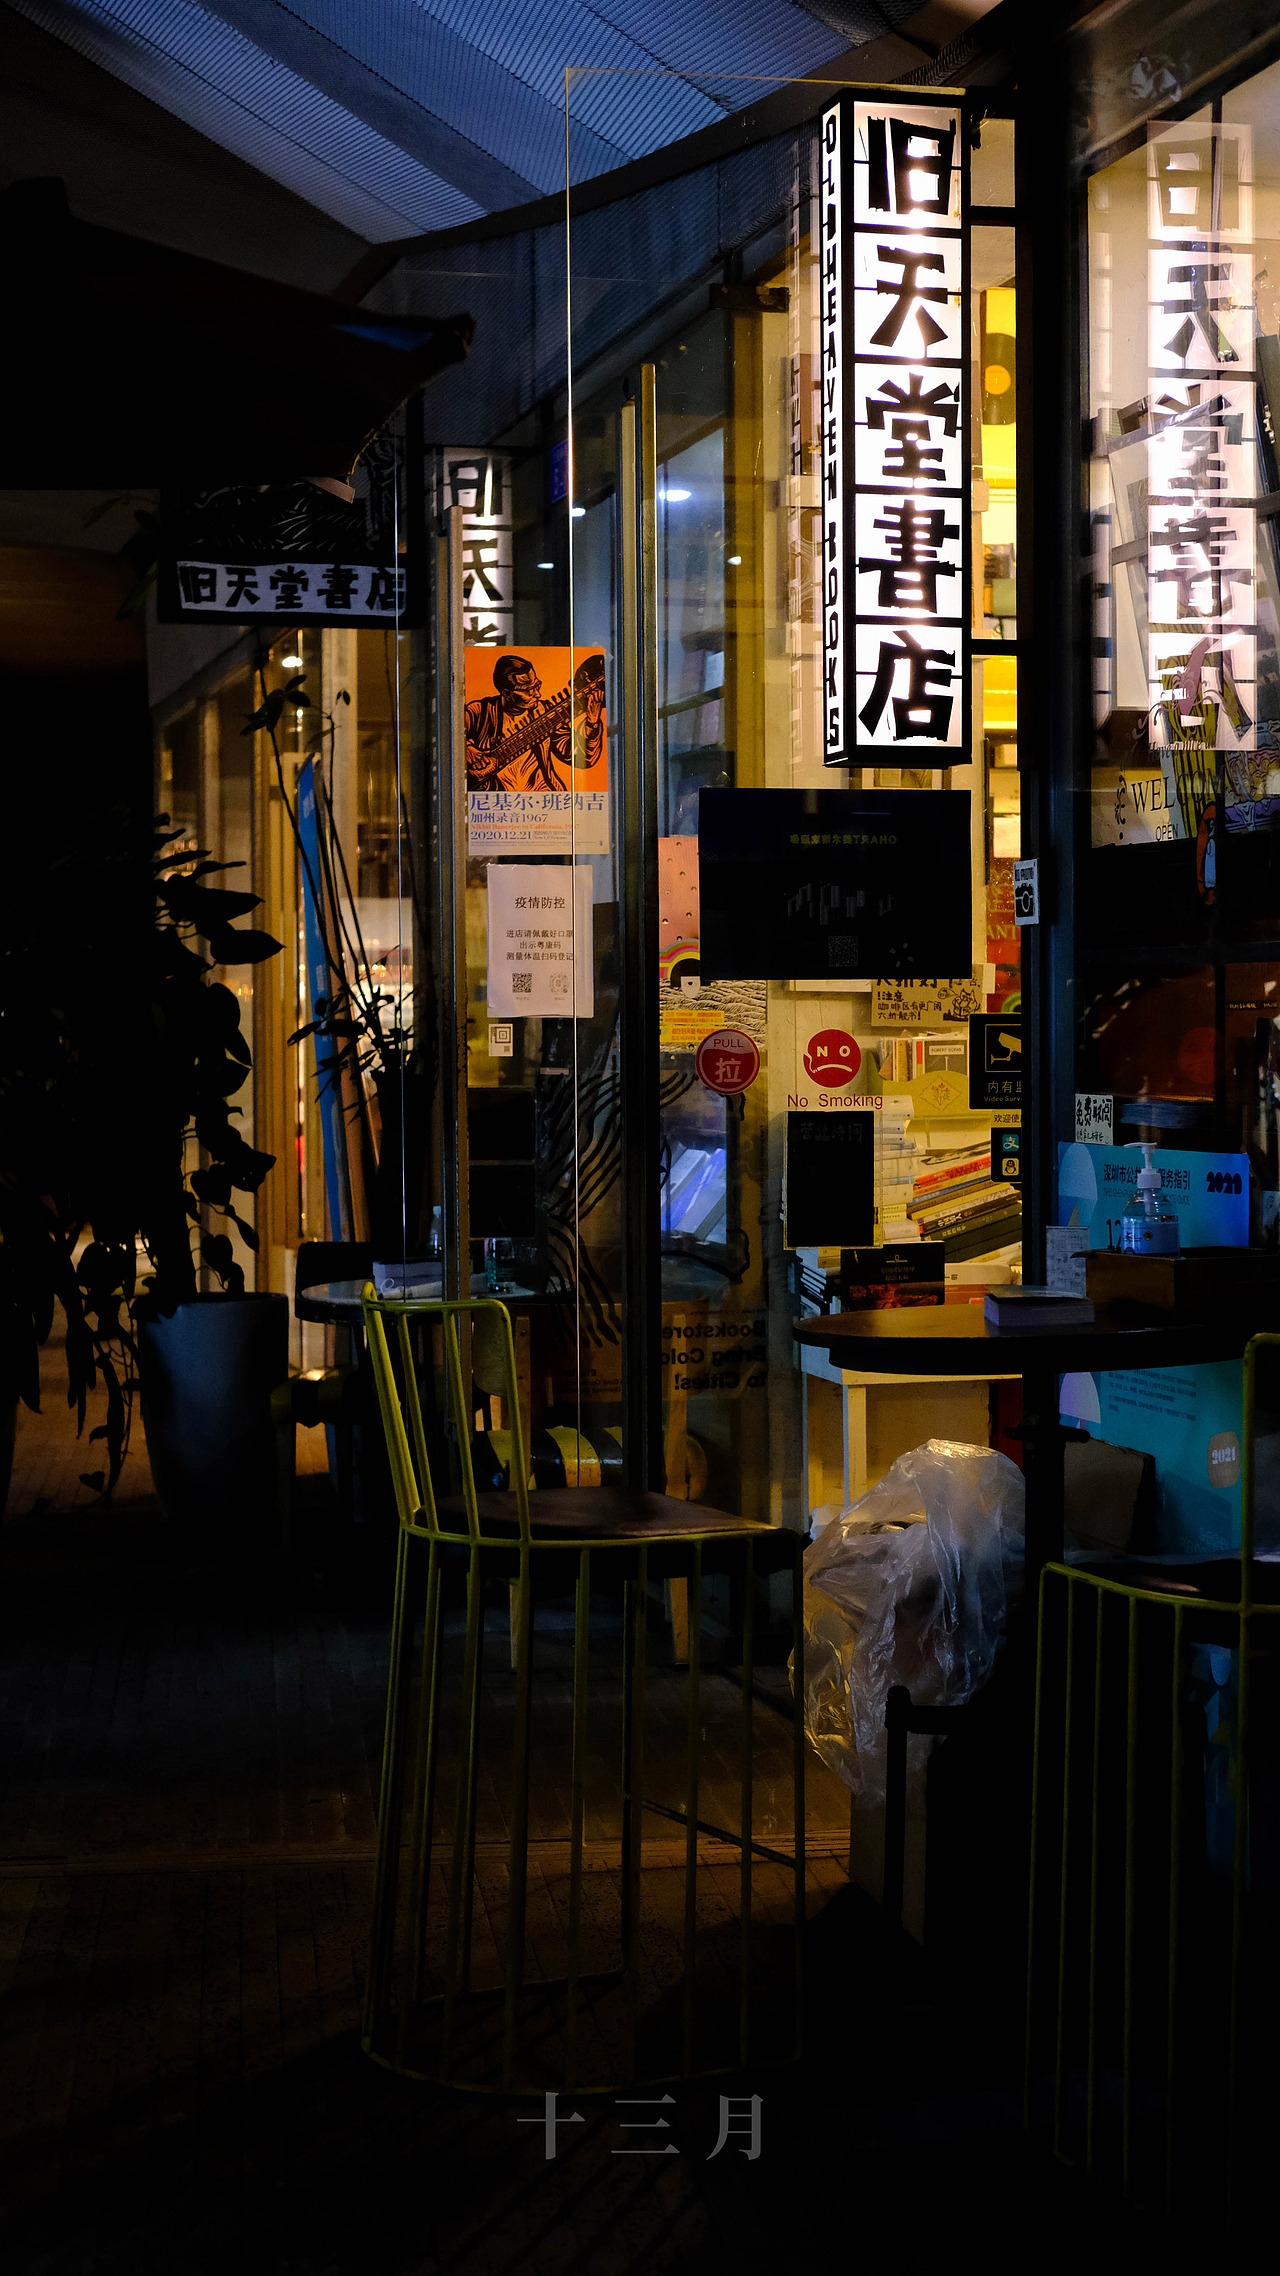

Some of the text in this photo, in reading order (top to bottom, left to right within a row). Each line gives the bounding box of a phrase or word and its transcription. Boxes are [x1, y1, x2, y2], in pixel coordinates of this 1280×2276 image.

[857, 115, 960, 747] 旧天堂書店
[181, 565, 407, 610] 旧天堂書店
[470, 793, 605, 811] 尼基尔·班纳吉
[470, 812, 548, 823] 加州录音1967
[470, 831, 531, 840] 2020.12.21
[1156, 824, 1178, 841] OPEN
[514, 896, 566, 909] 疫情防控
[506, 930, 574, 938] 进店请佩戴好口罩
[519, 941, 561, 949] 出示粤康码
[506, 952, 574, 960] 测量体温扫码登记
[713, 1038, 744, 1048] PULL
[715, 1057, 742, 1083] 拉
[787, 1093, 883, 1109] No Smoking
[993, 1114, 1021, 1123] 欢迎使
[1206, 1171, 1242, 1195] 2020
[1211, 1446, 1237, 1465] 2021
